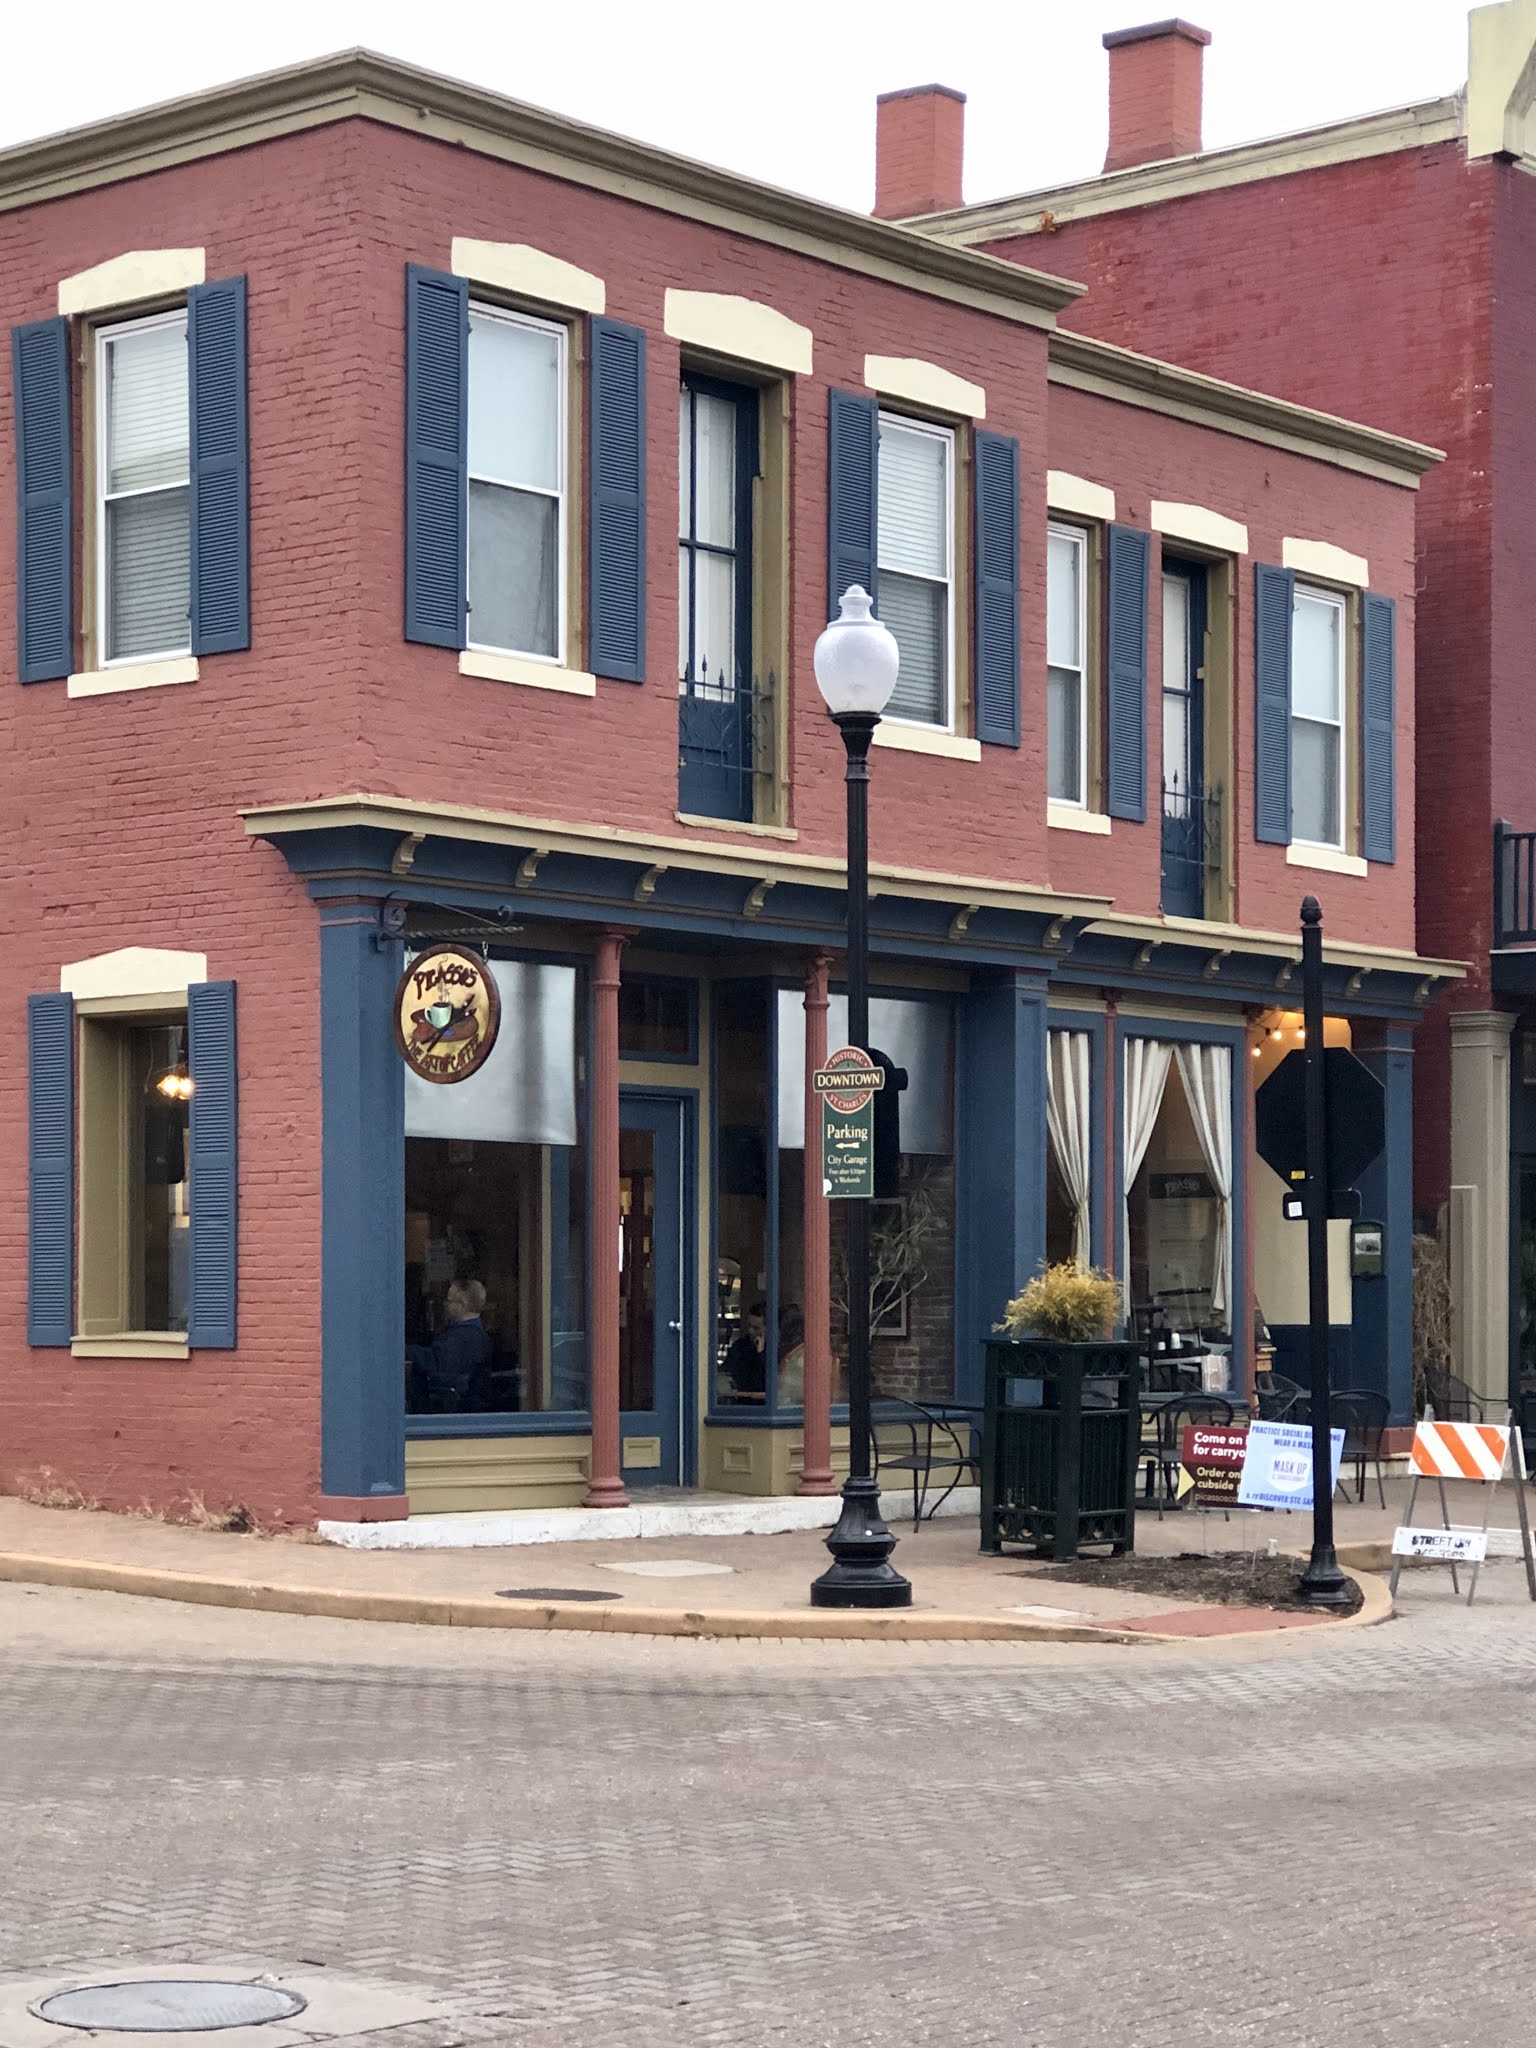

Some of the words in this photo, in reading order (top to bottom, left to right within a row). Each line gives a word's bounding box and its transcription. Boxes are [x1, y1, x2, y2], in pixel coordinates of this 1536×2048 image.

[831, 1051, 866, 1066] HISTORIC
[817, 1073, 881, 1088] DOWNTOWN
[837, 1094, 868, 1110] CHARLES
[827, 1124, 868, 1141] Parking
[827, 1154, 842, 1166] City
[843, 1153, 868, 1166] Garage
[1194, 1431, 1226, 1445] Come
[1228, 1436, 1243, 1446] on
[1251, 1425, 1281, 1436] PRACTICE
[1281, 1428, 1303, 1437] SOCIAL
[1273, 1438, 1291, 1447] WEAR
[1297, 1440, 1313, 1449] MAS
[1192, 1443, 1211, 1455] for
[1211, 1447, 1246, 1461] carryo
[1196, 1466, 1227, 1478] Order
[1273, 1459, 1295, 1474] MASK
[1296, 1462, 1308, 1475] UP
[1197, 1478, 1235, 1491] cubside
[1289, 1496, 1301, 1505] STC
